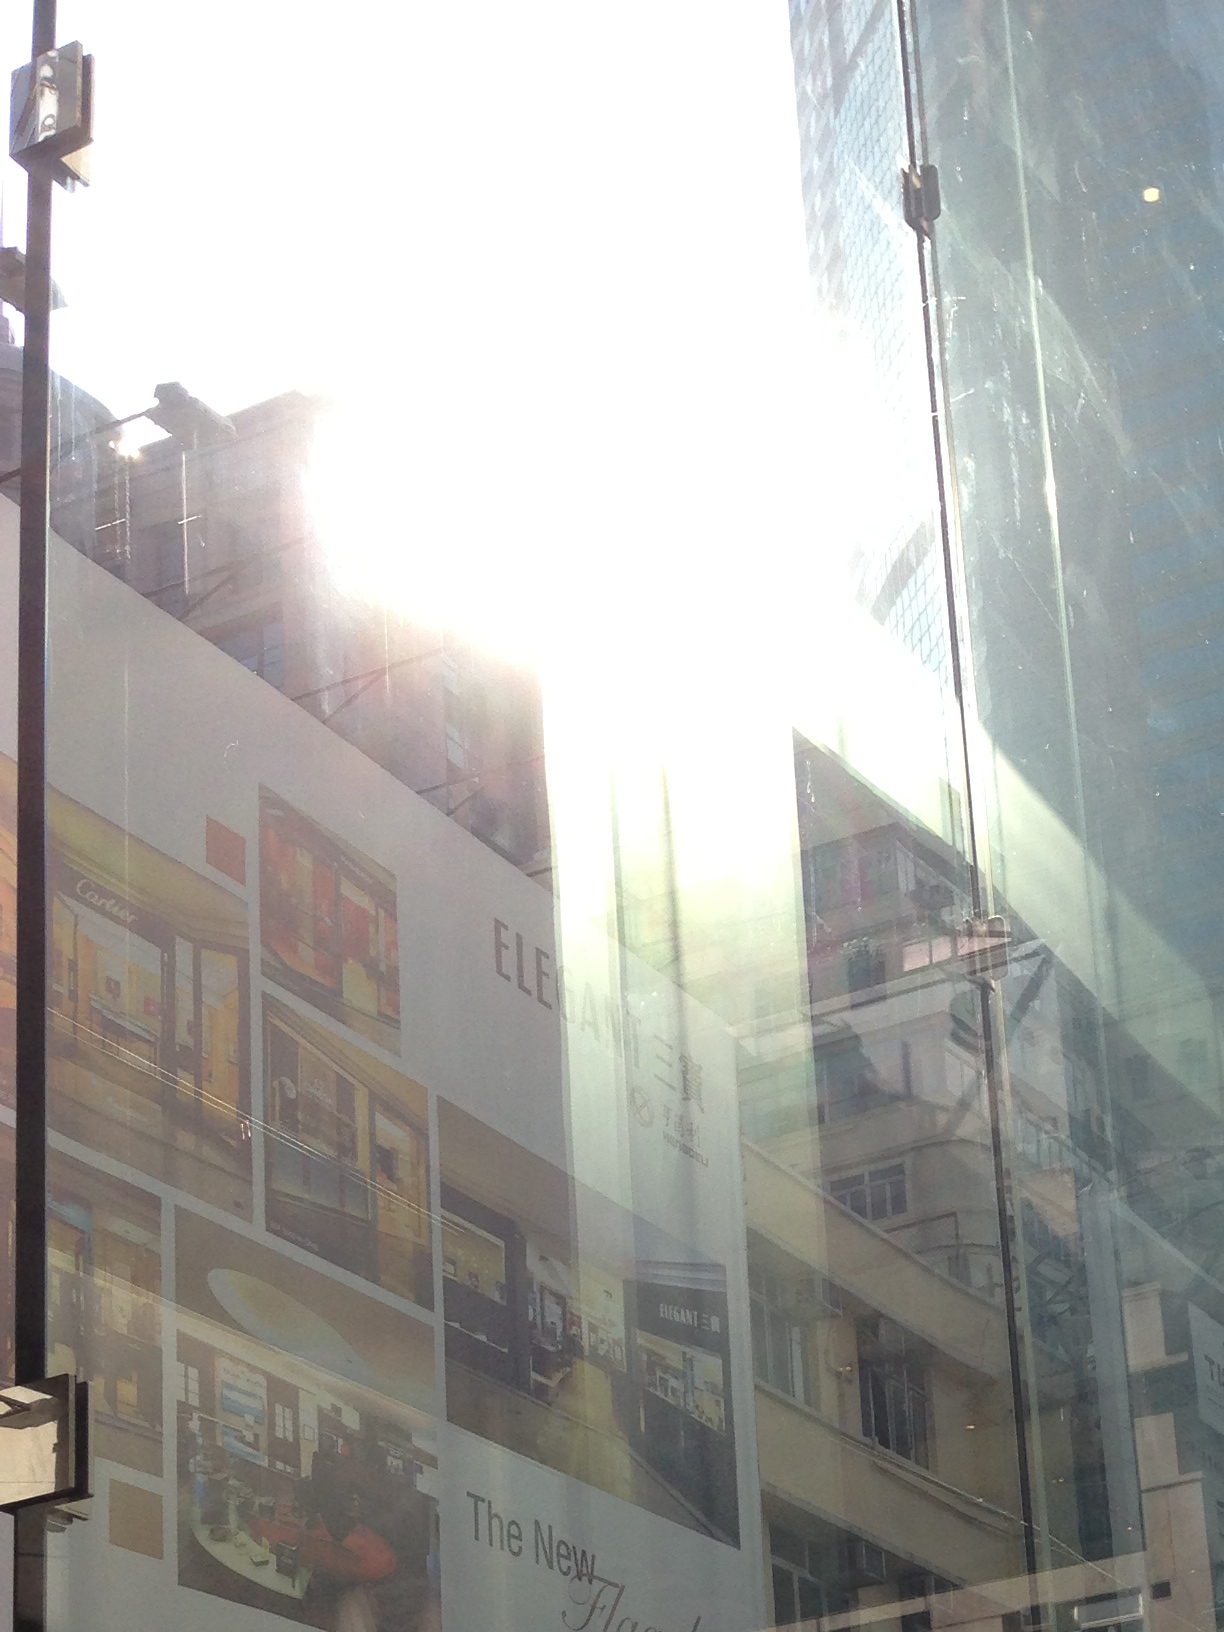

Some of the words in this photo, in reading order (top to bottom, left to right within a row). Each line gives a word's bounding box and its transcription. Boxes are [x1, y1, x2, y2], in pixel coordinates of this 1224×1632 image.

[76, 878, 138, 924] Cartier
[466, 1491, 523, 1558] The
[534, 1519, 596, 1585] New
